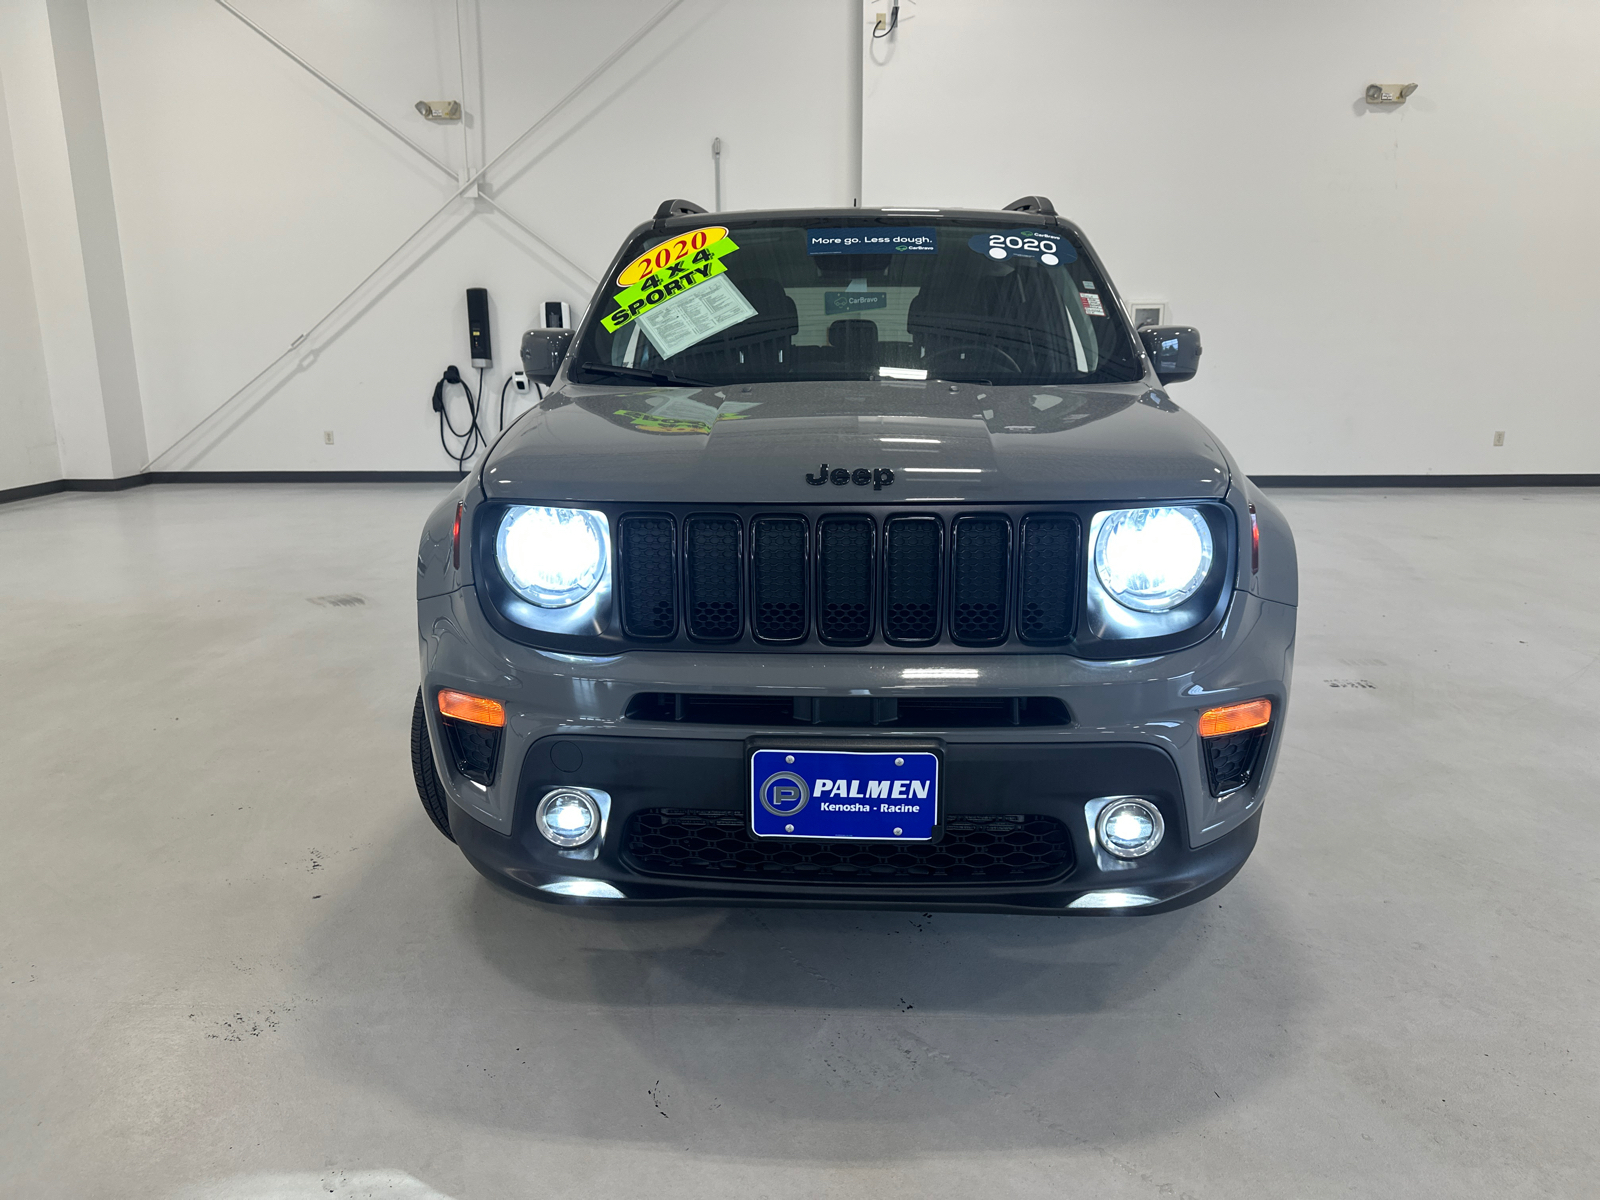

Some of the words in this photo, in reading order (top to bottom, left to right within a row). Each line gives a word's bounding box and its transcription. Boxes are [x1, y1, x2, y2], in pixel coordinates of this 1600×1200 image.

[844, 237, 861, 245] go.
[893, 236, 933, 245] dough.
[989, 234, 1057, 253] 2020
[637, 231, 707, 280] 2020
[641, 274, 663, 292] 4
[692, 248, 714, 264] 4
[610, 263, 713, 326] SPORTY
[848, 296, 878, 304] CarBravo
[805, 463, 895, 491] Jeep
[812, 778, 930, 799] PALMEN
[820, 802, 870, 812] Kenosha
[880, 803, 920, 813] Racine
